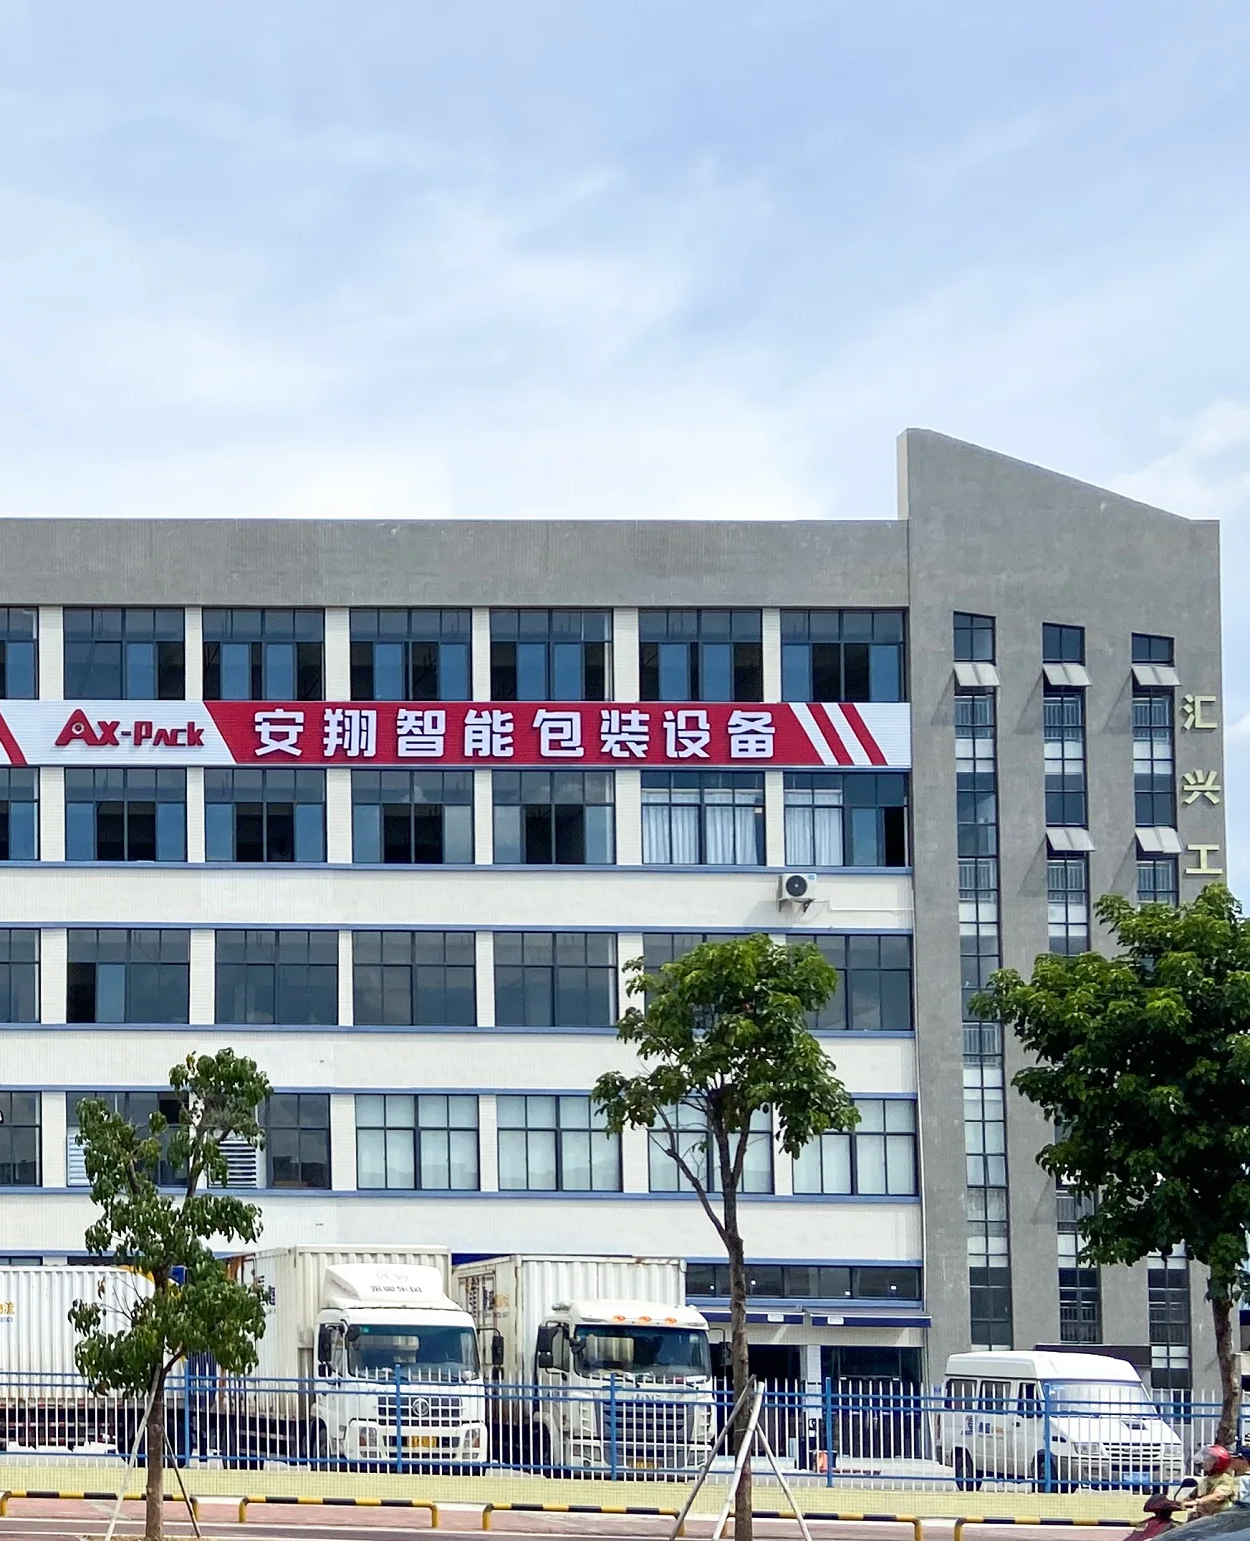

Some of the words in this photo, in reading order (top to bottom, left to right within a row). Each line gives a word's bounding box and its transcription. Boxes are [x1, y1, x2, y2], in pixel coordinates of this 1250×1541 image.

[253, 707, 777, 759] 安翔智能包装设备
